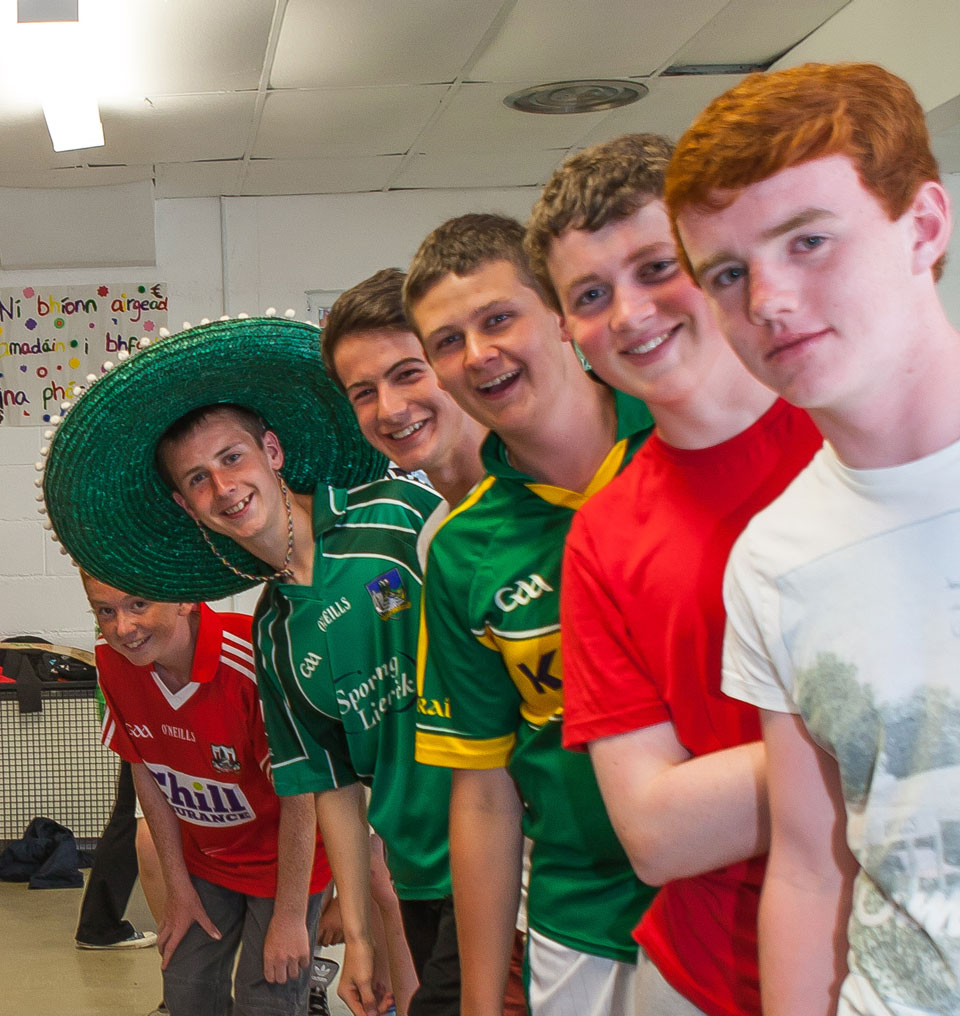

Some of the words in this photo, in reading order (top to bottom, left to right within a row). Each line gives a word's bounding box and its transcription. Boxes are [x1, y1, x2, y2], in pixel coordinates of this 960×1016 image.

[37, 294, 98, 317] bhíonn
[111, 292, 168, 323] airgead
[84, 338, 89, 355] i
[42, 380, 85, 411] phó
[174, 806, 252, 823] URANCE
